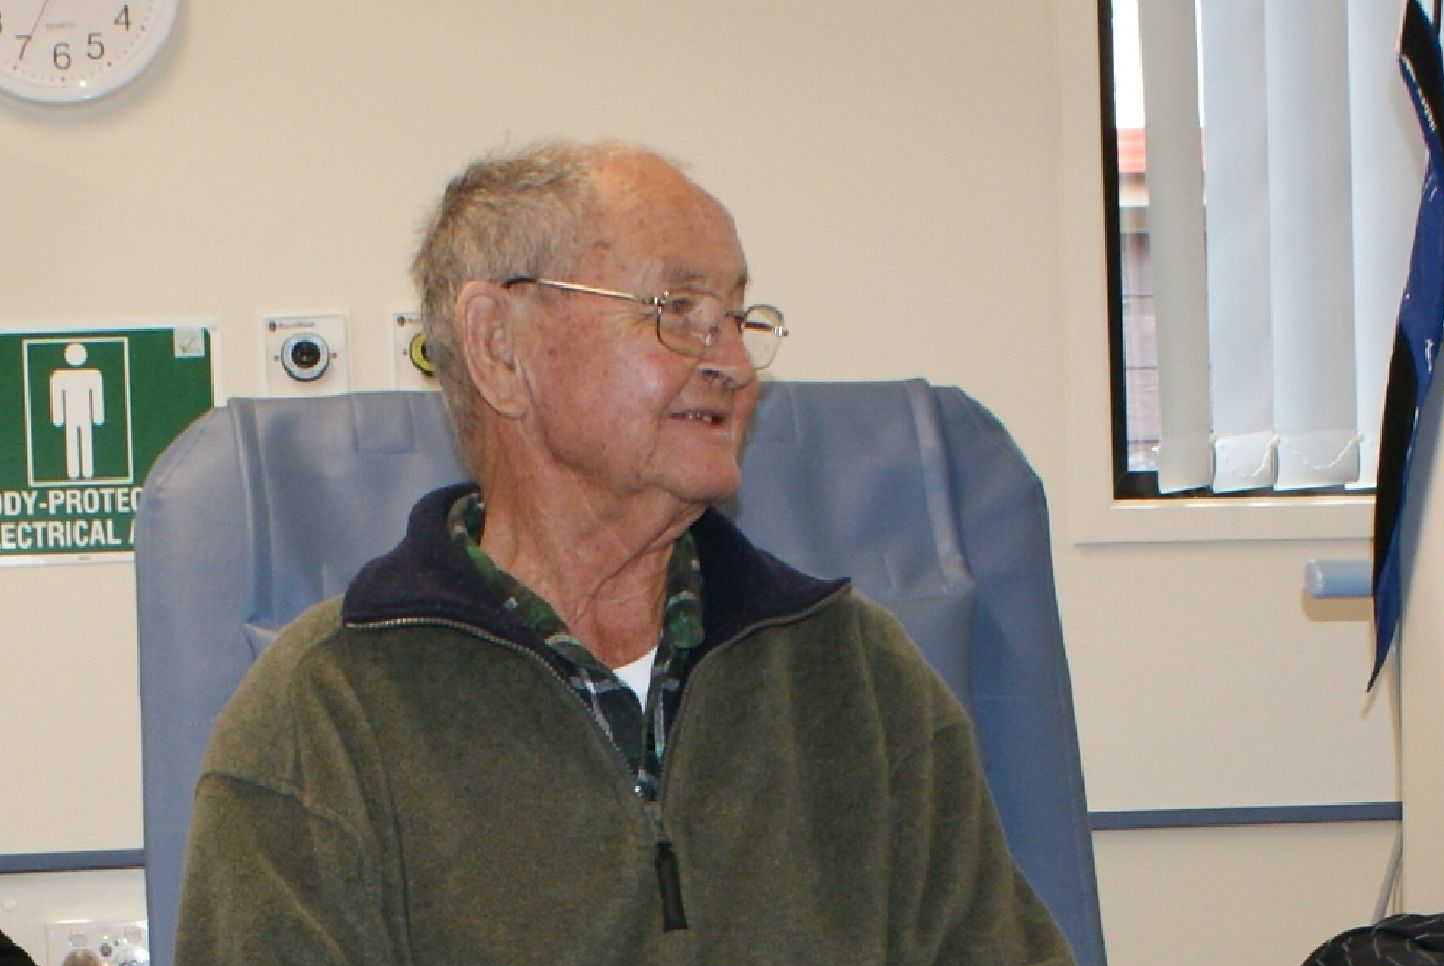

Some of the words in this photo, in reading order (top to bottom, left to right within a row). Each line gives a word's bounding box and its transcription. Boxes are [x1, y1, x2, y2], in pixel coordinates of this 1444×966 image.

[113, 4, 131, 32] 4
[15, 34, 32, 61] 7
[53, 41, 72, 70] 6
[87, 32, 105, 60] 5
[0, 487, 143, 516] DY-PROTEC
[0, 519, 122, 549] ECTRICAL
